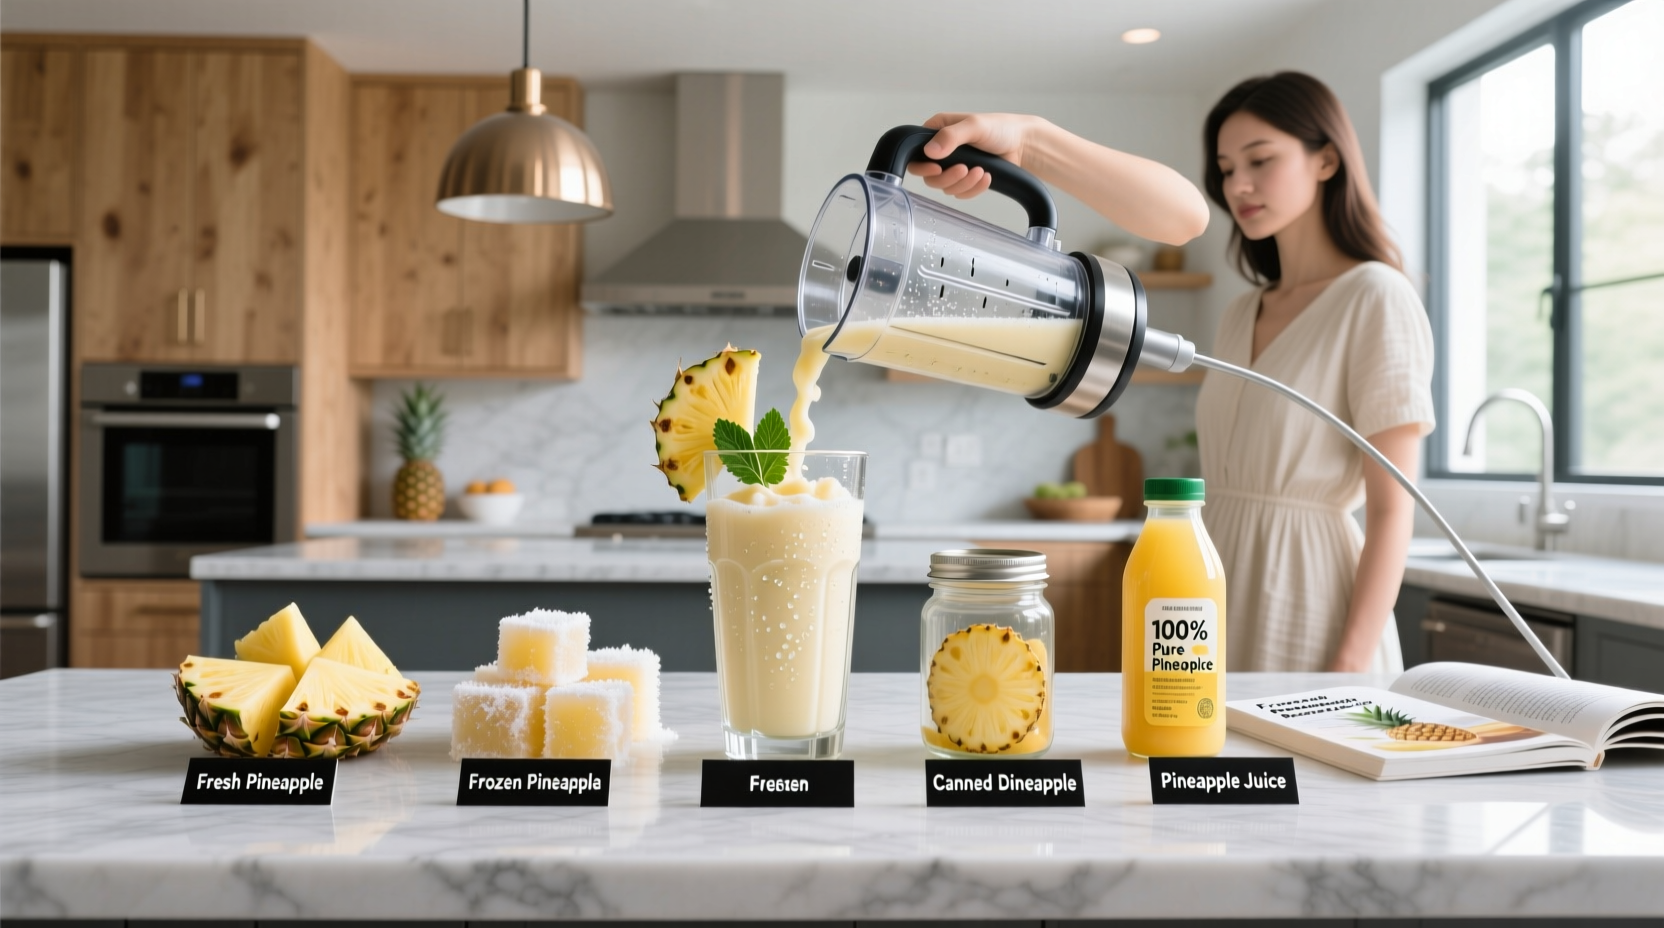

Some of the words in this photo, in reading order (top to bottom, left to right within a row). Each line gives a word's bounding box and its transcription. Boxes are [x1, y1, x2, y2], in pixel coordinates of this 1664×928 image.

[1152, 619, 1208, 640] 100%
[1152, 642, 1185, 656] Pure
[197, 772, 241, 790] Fresh
[246, 772, 324, 795] Pineapple
[469, 773, 522, 790] Frozen
[933, 773, 993, 791] Canned
[998, 773, 1077, 795] Dineapple
[1161, 771, 1240, 793] Pineapple
[1244, 771, 1287, 789] Juice
